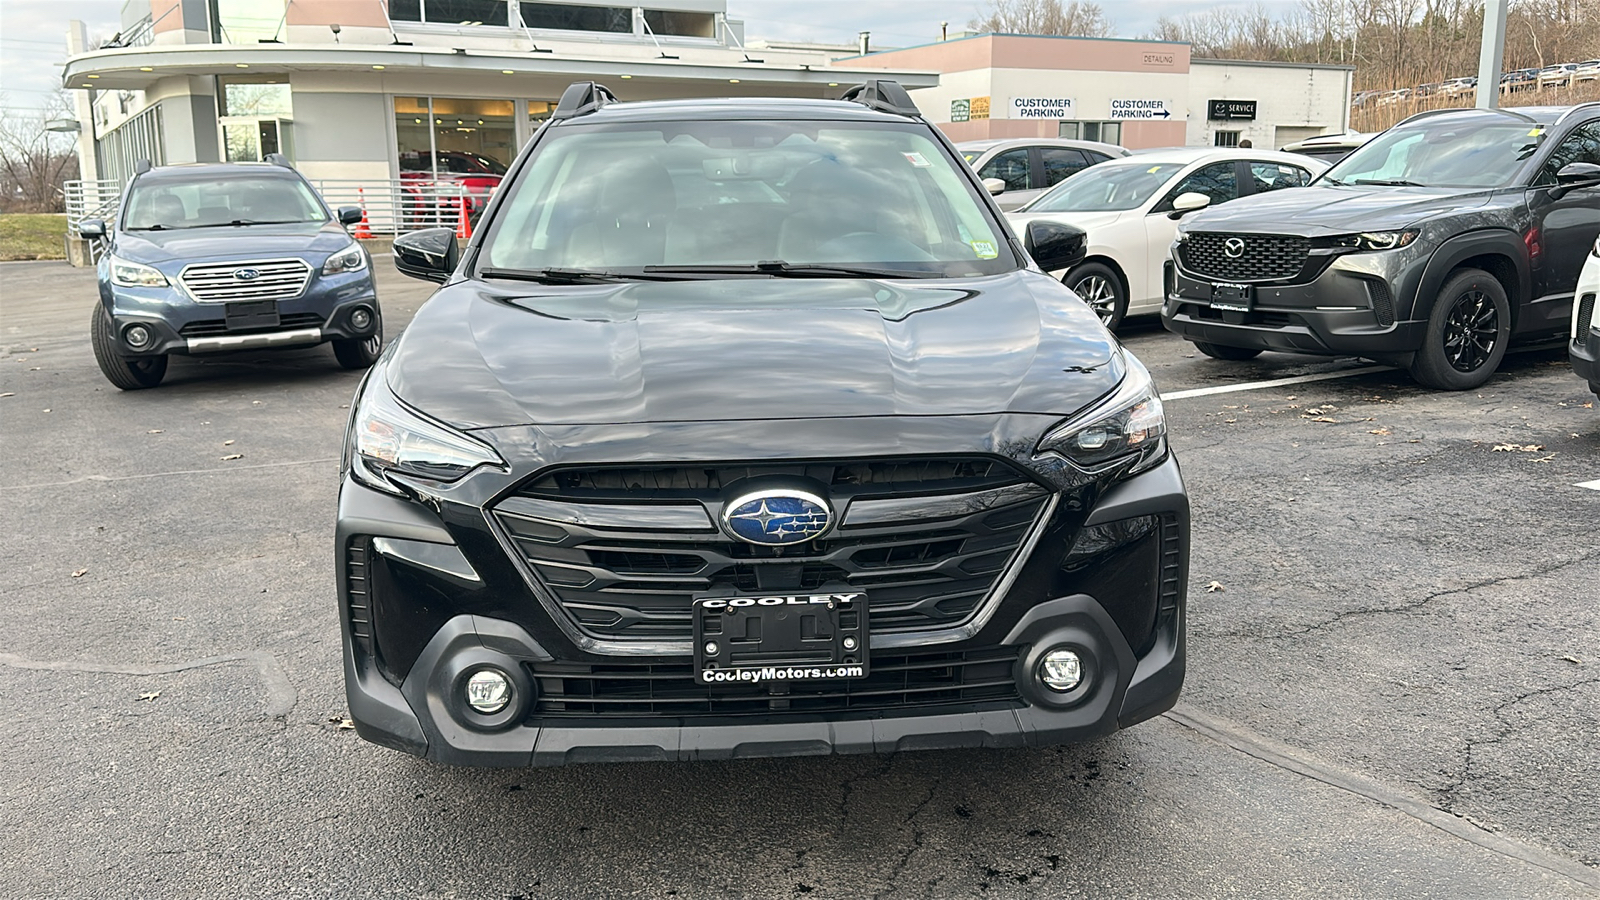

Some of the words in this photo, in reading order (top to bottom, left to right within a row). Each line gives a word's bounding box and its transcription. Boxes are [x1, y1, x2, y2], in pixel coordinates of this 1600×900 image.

[1143, 55, 1173, 64] DETAILING
[1014, 98, 1071, 108] CUSTOMER
[1111, 100, 1164, 109] CUSTOMER
[1228, 104, 1254, 112] SERVICE
[1020, 108, 1065, 118] PARKING
[1111, 109, 1153, 119] PARKING
[702, 594, 858, 607] COOLEY
[702, 666, 863, 683] CooleyMotors.com
